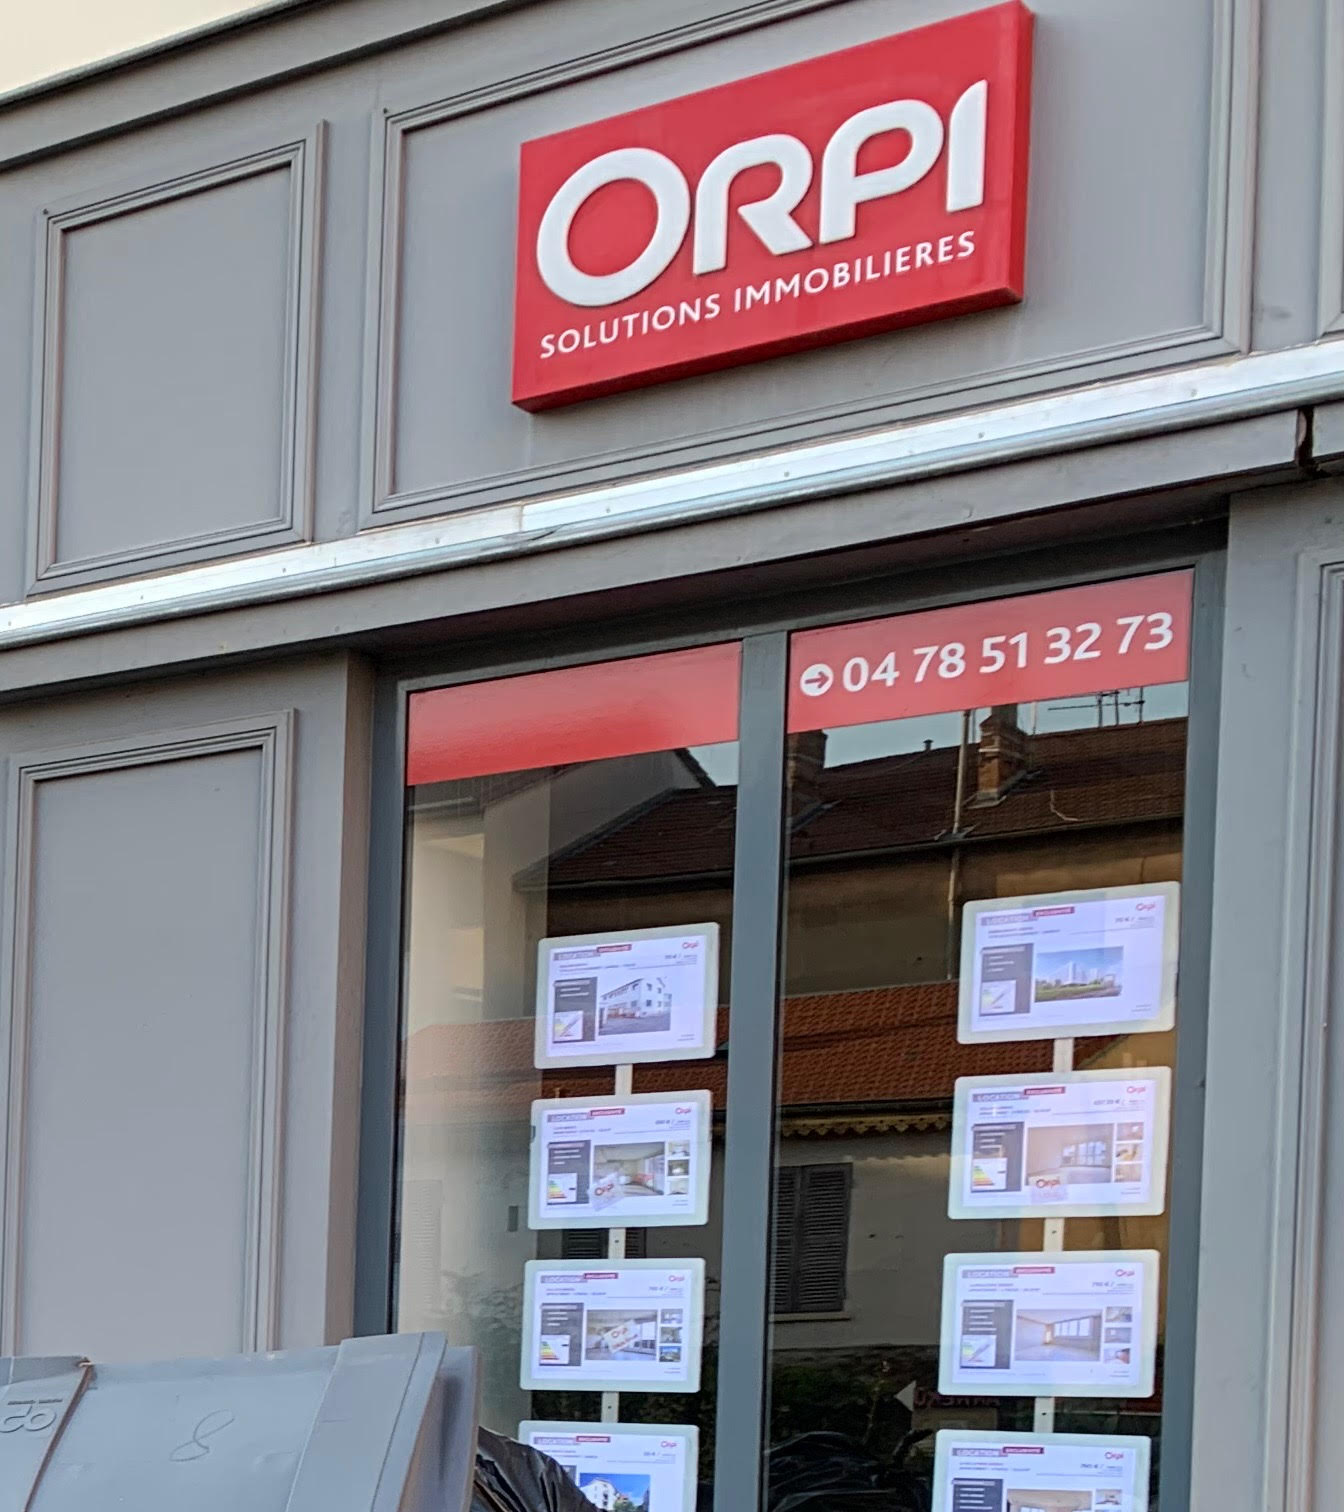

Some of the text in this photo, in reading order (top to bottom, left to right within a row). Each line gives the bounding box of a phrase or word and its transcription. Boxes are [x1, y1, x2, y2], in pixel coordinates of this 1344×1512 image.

[536, 80, 988, 307] ORPI
[539, 229, 977, 360] SOLUTIONS IMMOBILIERES
[841, 612, 1174, 693] 04 78 51 32 73
